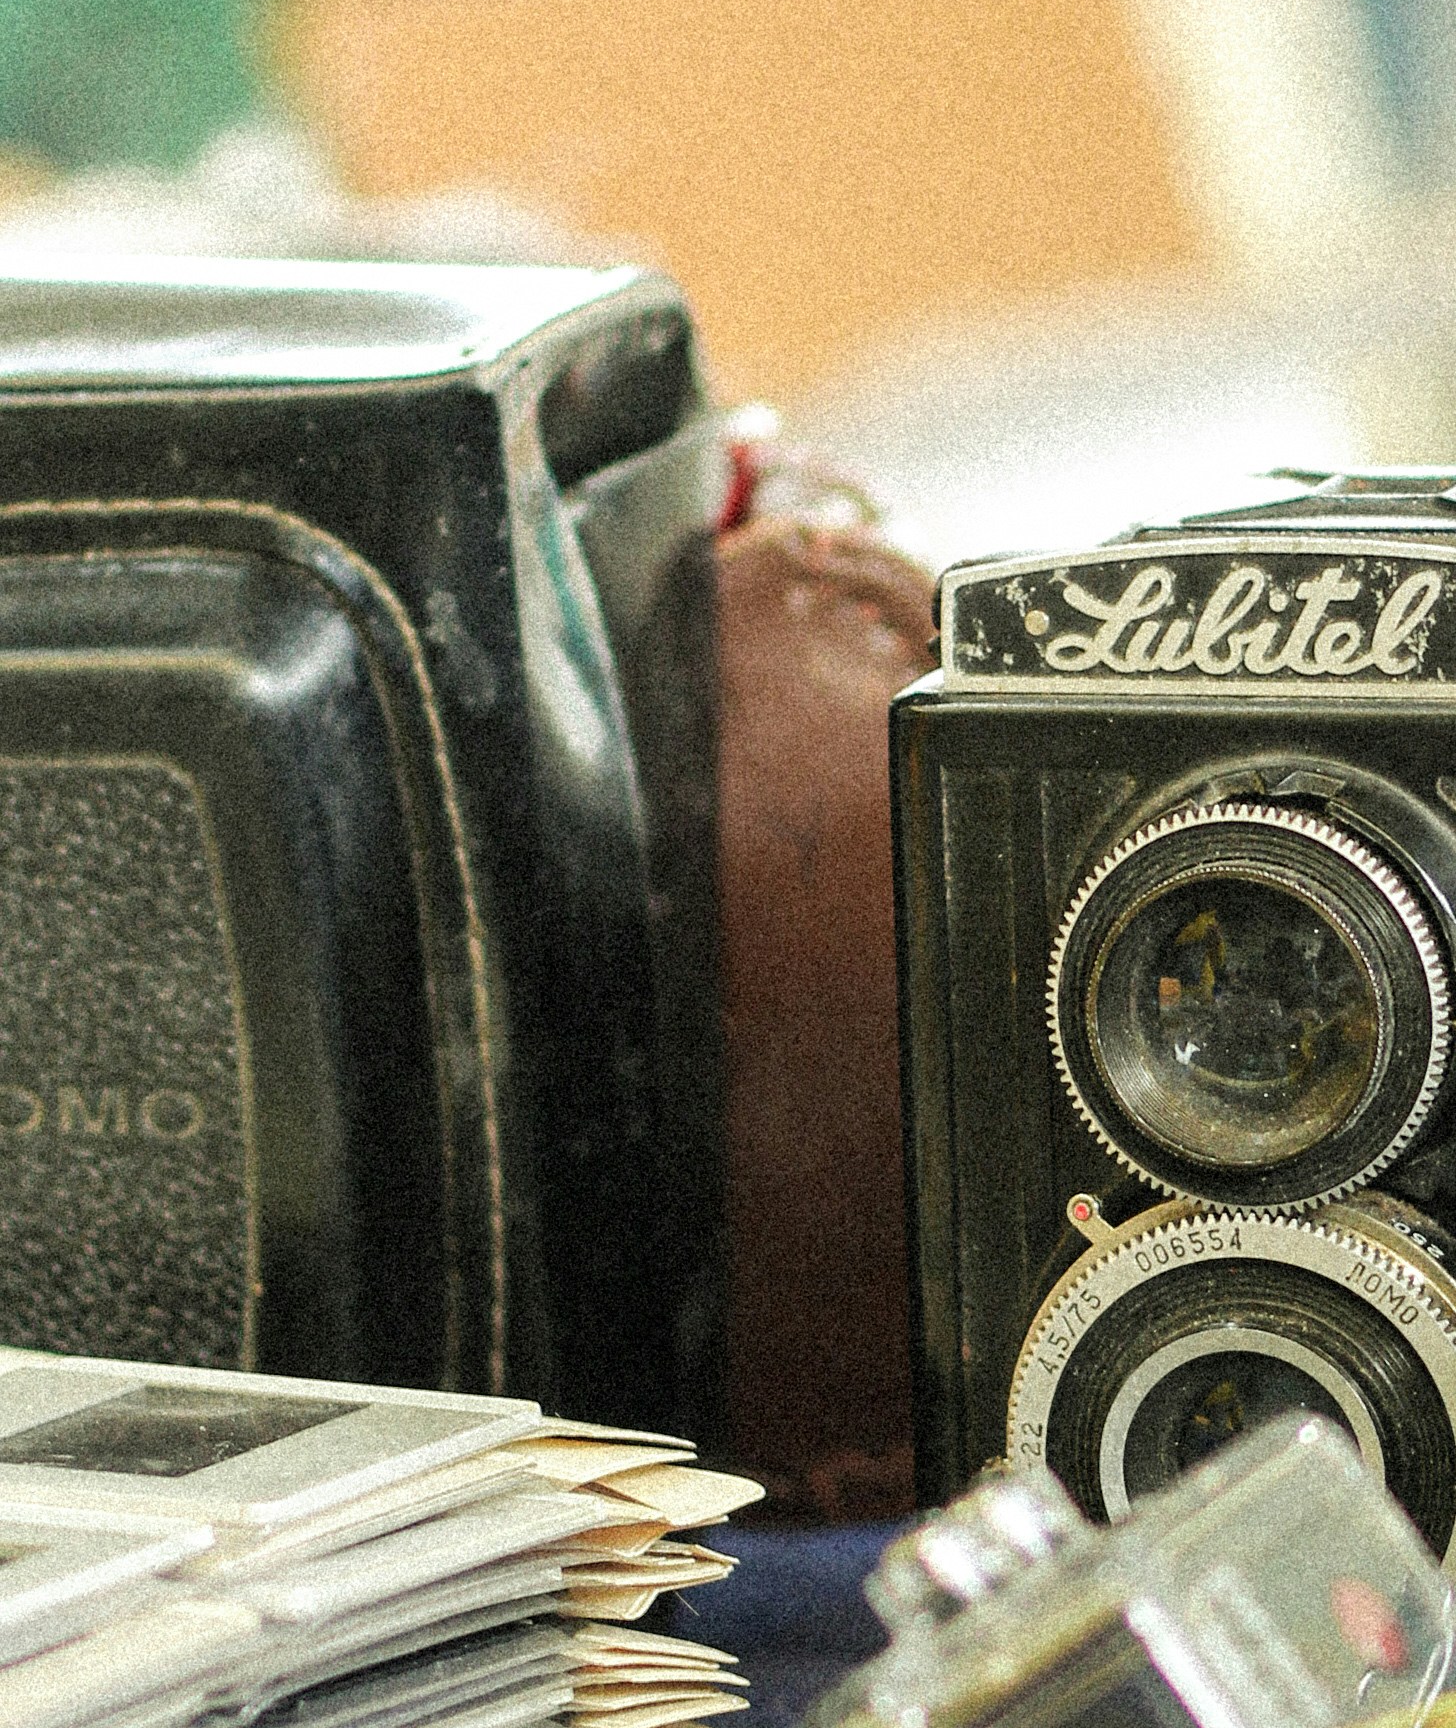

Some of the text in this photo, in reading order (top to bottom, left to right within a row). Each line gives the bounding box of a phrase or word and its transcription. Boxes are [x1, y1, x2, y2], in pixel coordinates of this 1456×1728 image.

[1046, 564, 1441, 677] Lubitel
[1393, 1219, 1445, 1259] 250
[1039, 1290, 1101, 1375] 4,5/75
[1135, 1228, 1243, 1272] 006554
